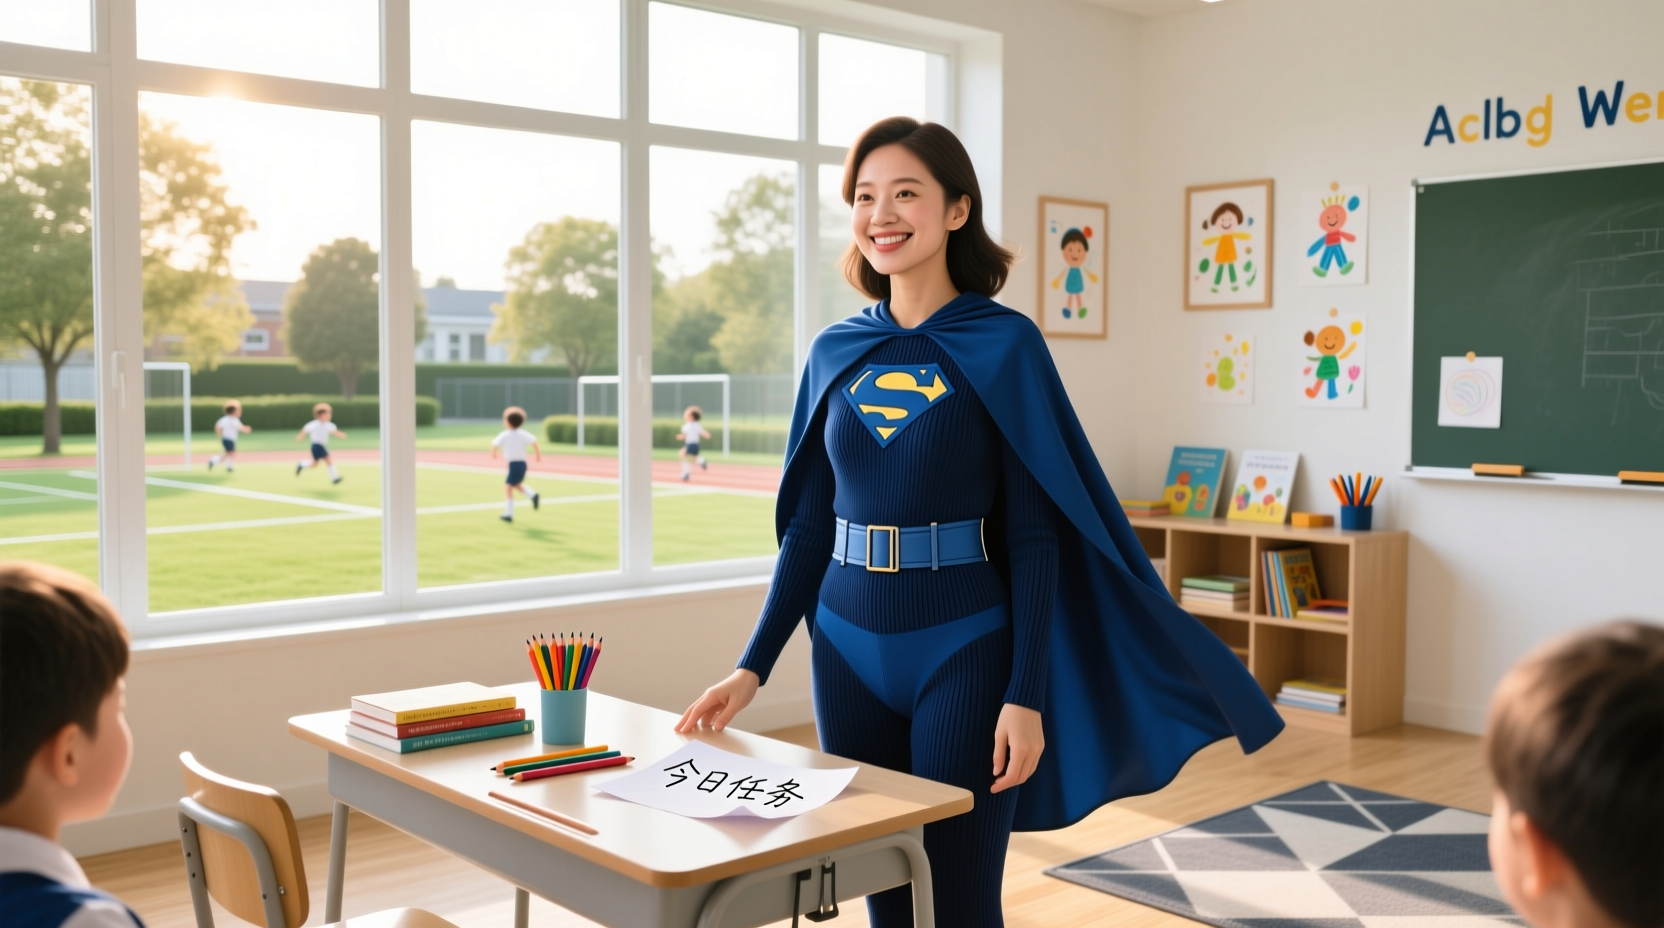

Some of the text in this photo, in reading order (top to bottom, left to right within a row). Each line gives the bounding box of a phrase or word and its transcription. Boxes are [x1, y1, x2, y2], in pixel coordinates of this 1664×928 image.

[849, 365, 943, 432] S
[663, 758, 804, 808] 今日任务
